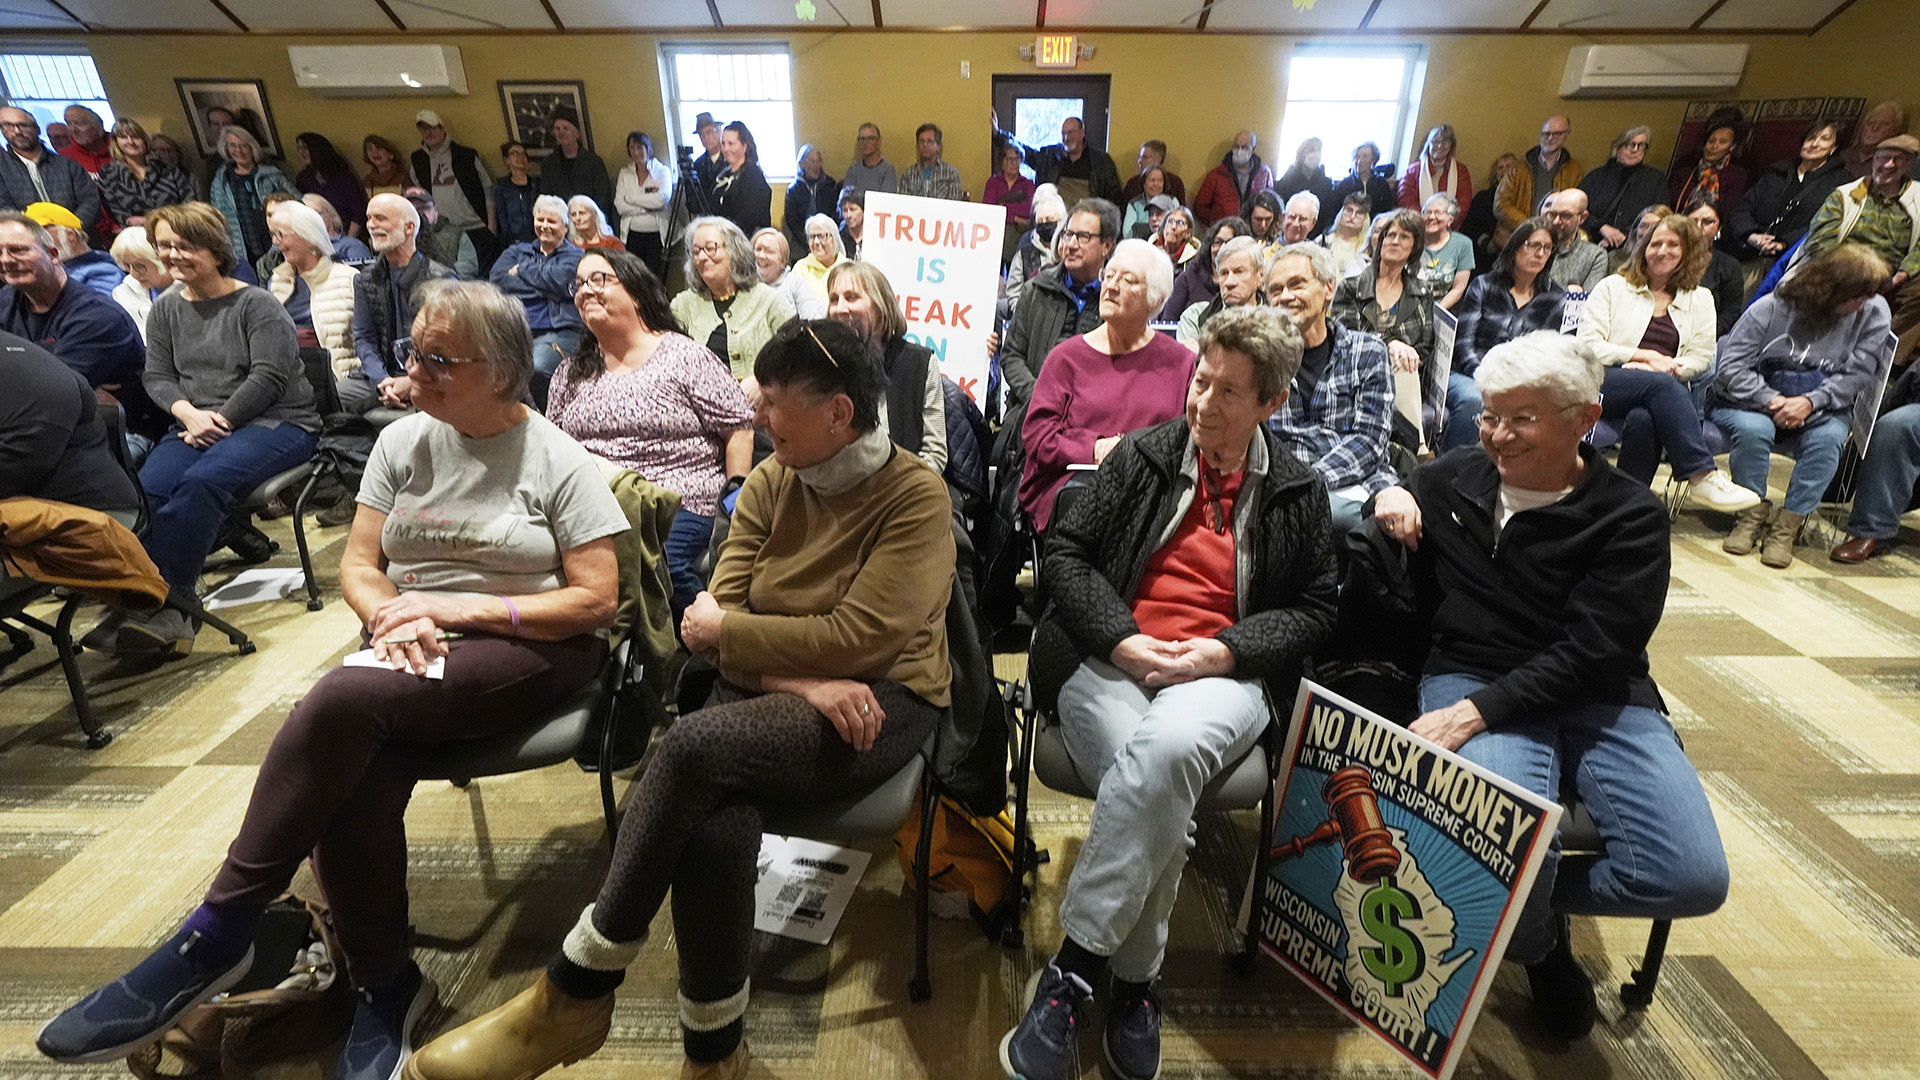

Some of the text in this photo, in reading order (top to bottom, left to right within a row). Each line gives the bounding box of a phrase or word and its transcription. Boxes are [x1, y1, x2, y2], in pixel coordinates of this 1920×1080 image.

[1043, 36, 1072, 64] EXIT
[874, 212, 990, 250] TRUMP
[916, 256, 946, 284] IS
[896, 294, 973, 329] EAK
[1305, 704, 1345, 750] NO
[1345, 715, 1427, 788] MUSK
[1425, 754, 1536, 857] MONEY
[1300, 747, 1516, 883] IN THE SUPREME COURT!
[1265, 876, 1341, 948] WISCONSIN
